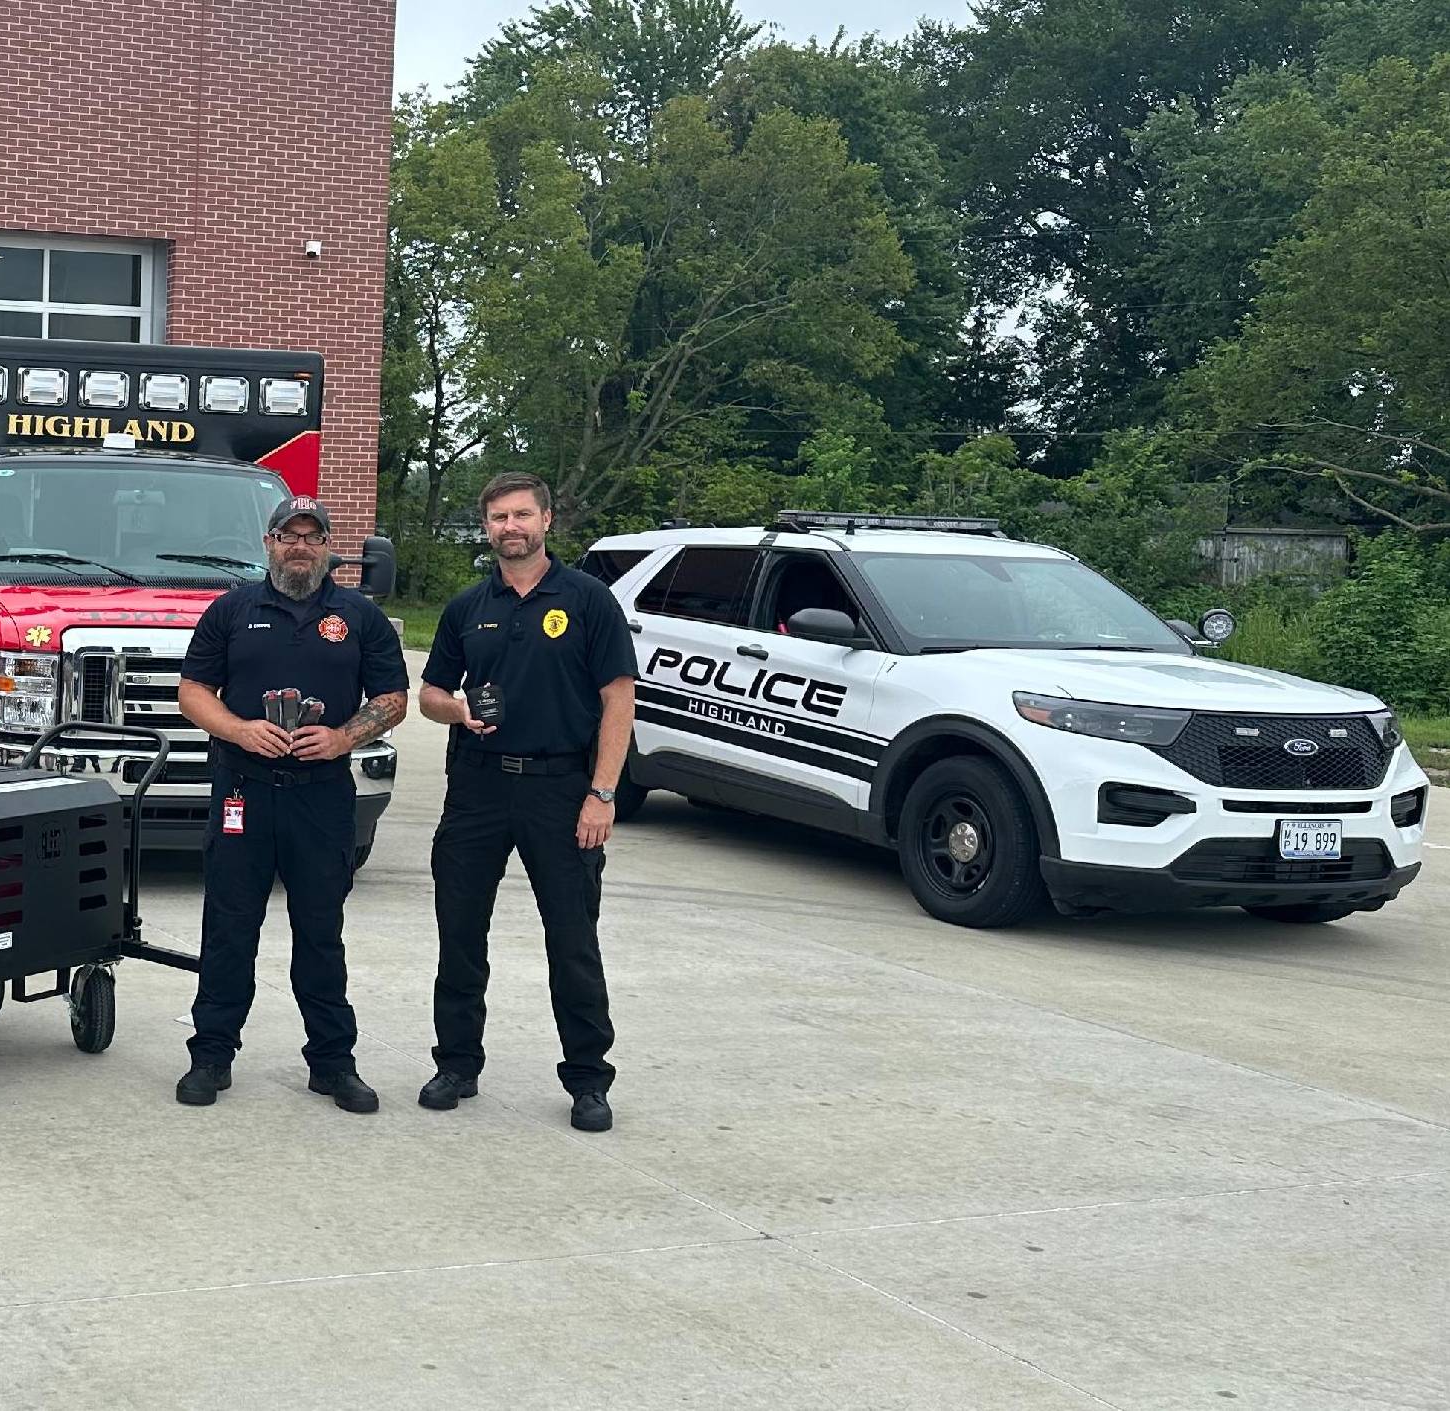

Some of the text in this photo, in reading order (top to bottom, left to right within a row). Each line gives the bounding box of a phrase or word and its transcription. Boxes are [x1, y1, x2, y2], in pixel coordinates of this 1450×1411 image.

[8, 413, 196, 442] HIGHLAND
[645, 646, 848, 718] POLICE
[688, 698, 786, 736] HIGHLAND
[1293, 832, 1337, 851] 19 899
